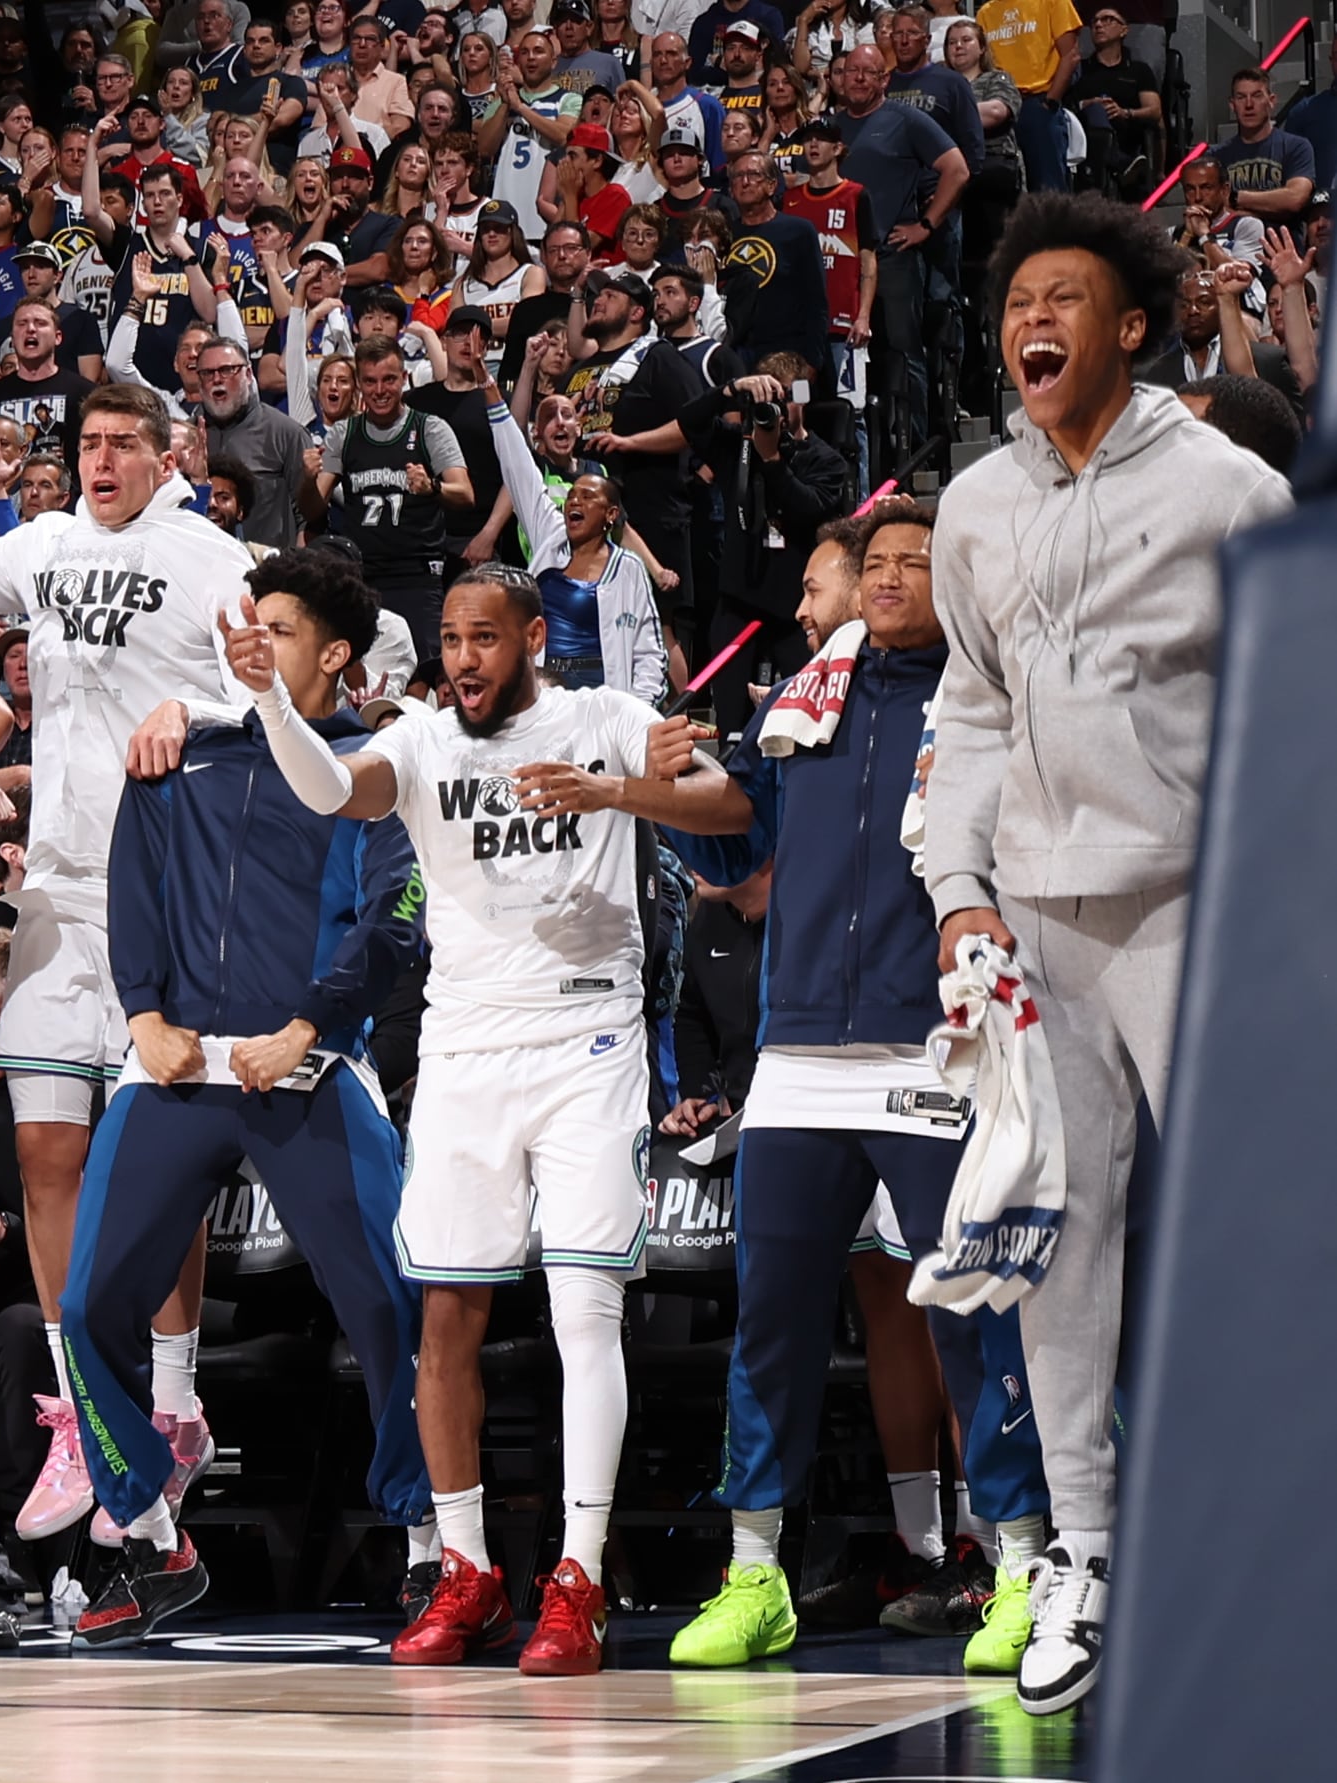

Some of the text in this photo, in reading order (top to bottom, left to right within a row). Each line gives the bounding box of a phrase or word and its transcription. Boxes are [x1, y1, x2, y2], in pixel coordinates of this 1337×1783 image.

[512, 140, 532, 170] 5
[827, 208, 846, 230] 15
[229, 265, 243, 283] 7
[234, 249, 258, 278] HIGH
[143, 299, 169, 326] 15
[349, 467, 408, 494] TIMBERWOLV
[361, 494, 404, 527] 21
[473, 813, 583, 862] BACK
[207, 1234, 284, 1256] Google Pixel
[673, 1231, 724, 1253] Google
[78, 1395, 129, 1477] TIMBERWOLVES
